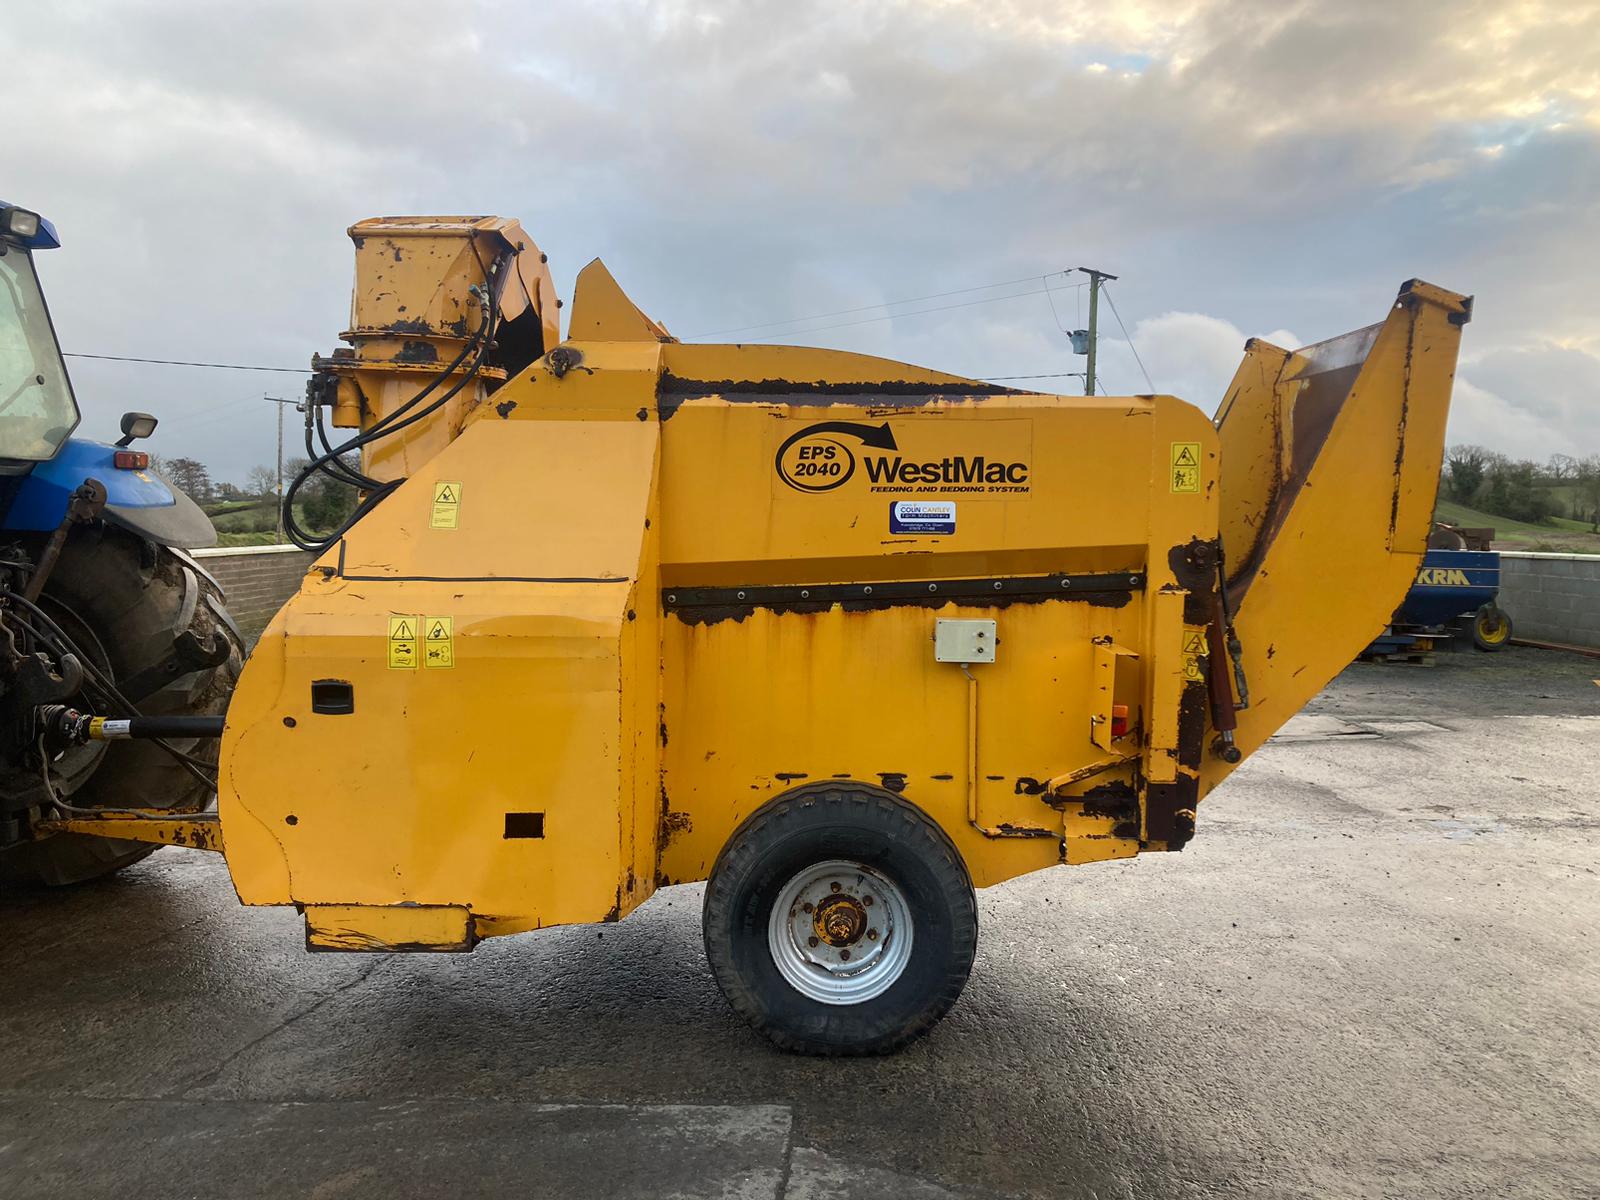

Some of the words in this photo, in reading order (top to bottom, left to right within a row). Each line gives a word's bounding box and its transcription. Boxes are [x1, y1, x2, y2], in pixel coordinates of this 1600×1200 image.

[798, 446, 836, 460] EPS
[794, 462, 841, 477] 2040
[863, 456, 1028, 483] WestMac
[1417, 569, 1470, 585] KRM
